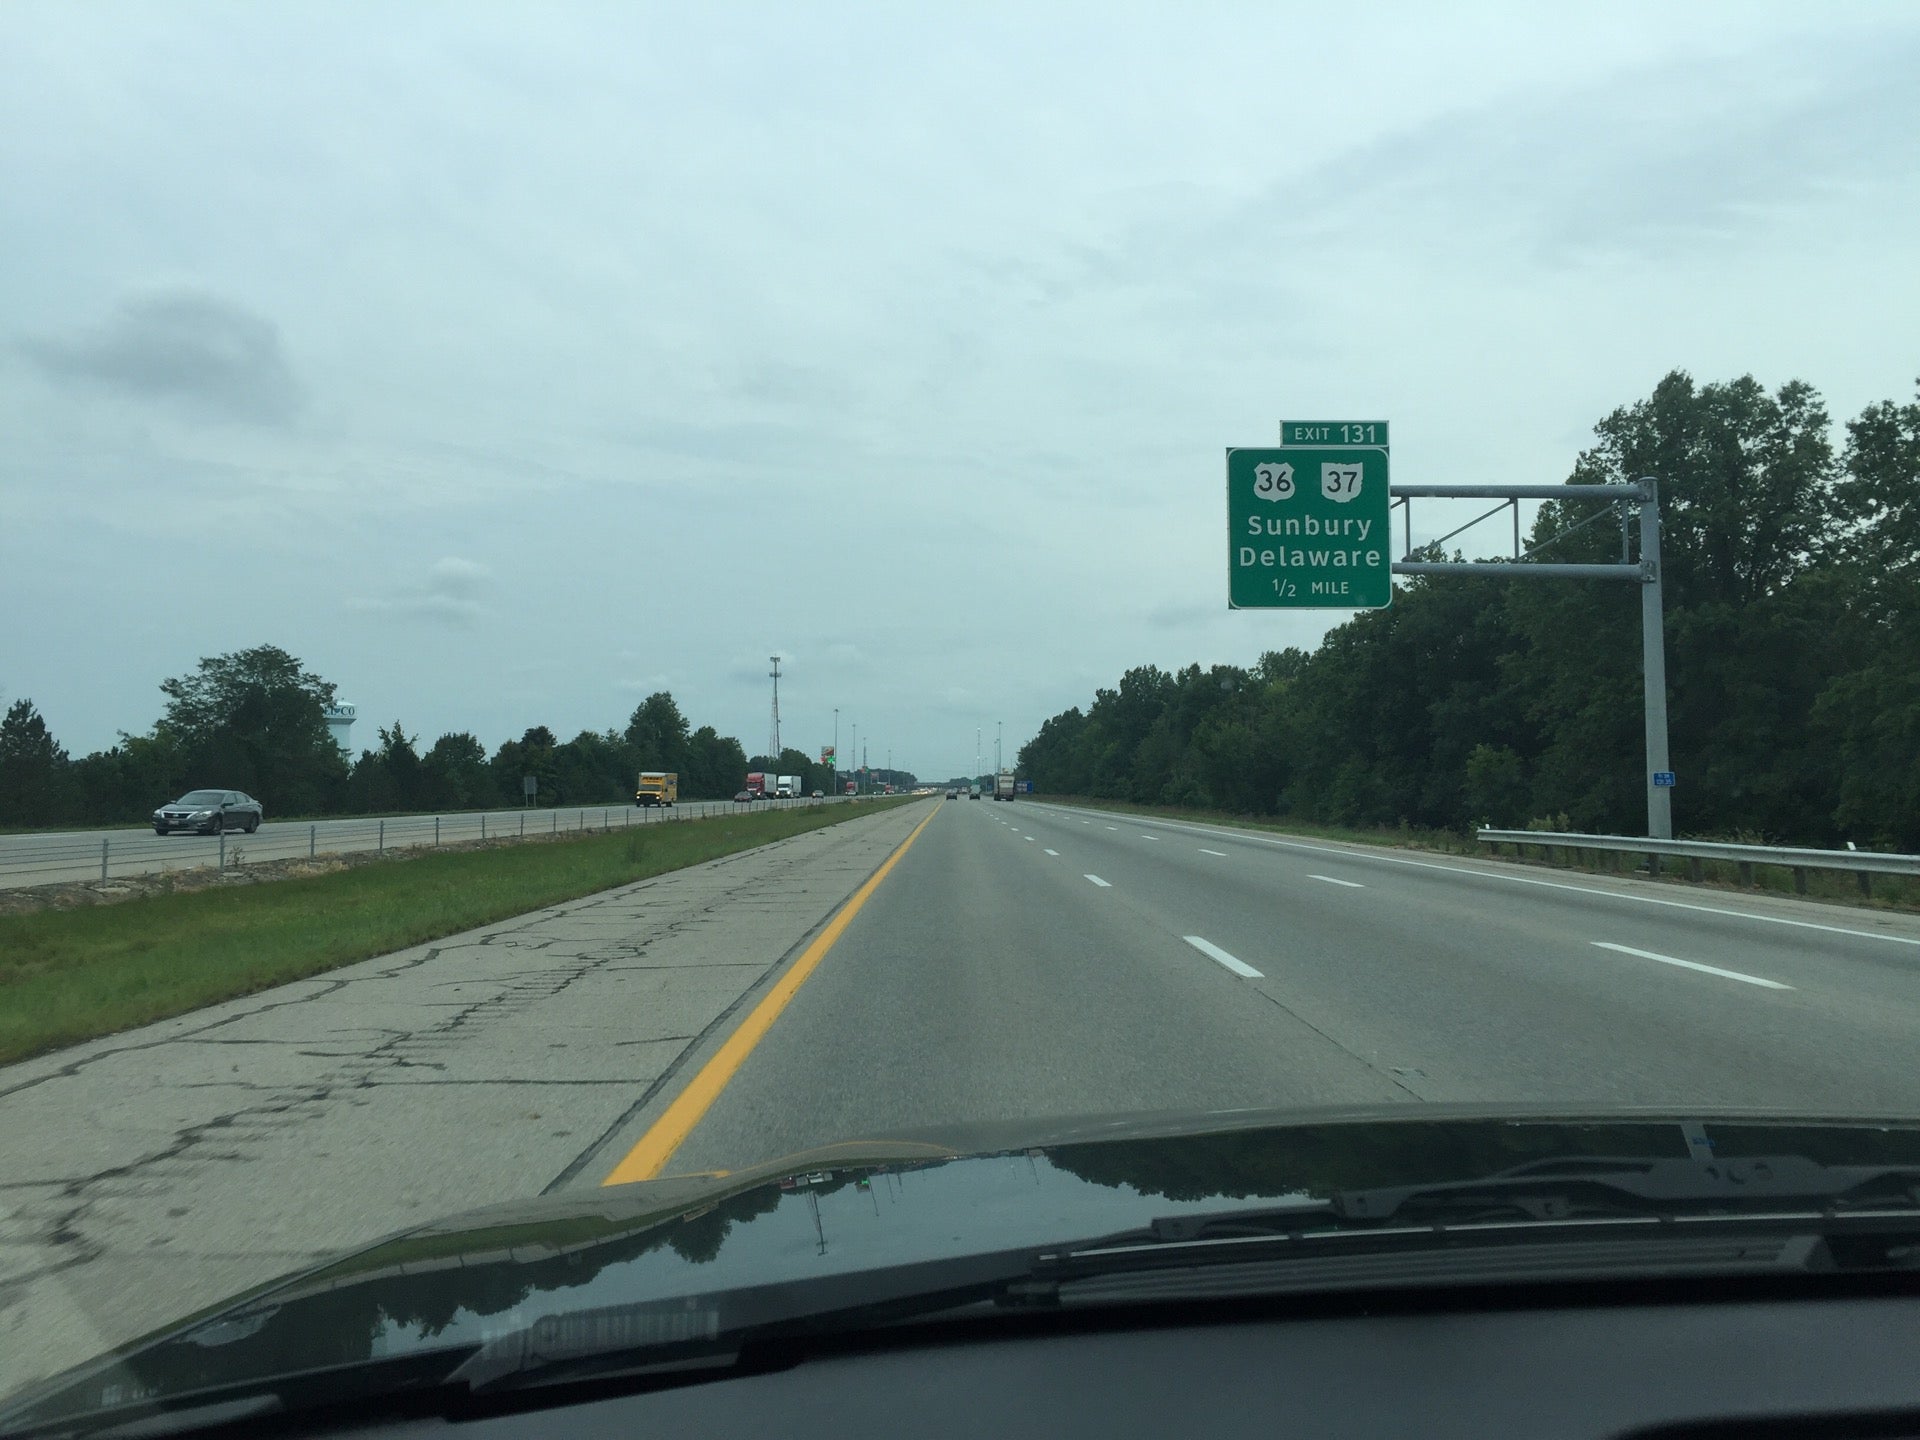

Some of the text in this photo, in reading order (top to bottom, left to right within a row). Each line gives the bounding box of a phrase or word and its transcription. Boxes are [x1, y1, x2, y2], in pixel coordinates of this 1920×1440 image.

[1295, 425, 1376, 443] EXIT 131
[1258, 470, 1358, 493] 36 37
[1248, 514, 1372, 541] Sunbury
[1240, 546, 1381, 567] Delaware
[1272, 578, 1349, 597] 1/2 MILE
